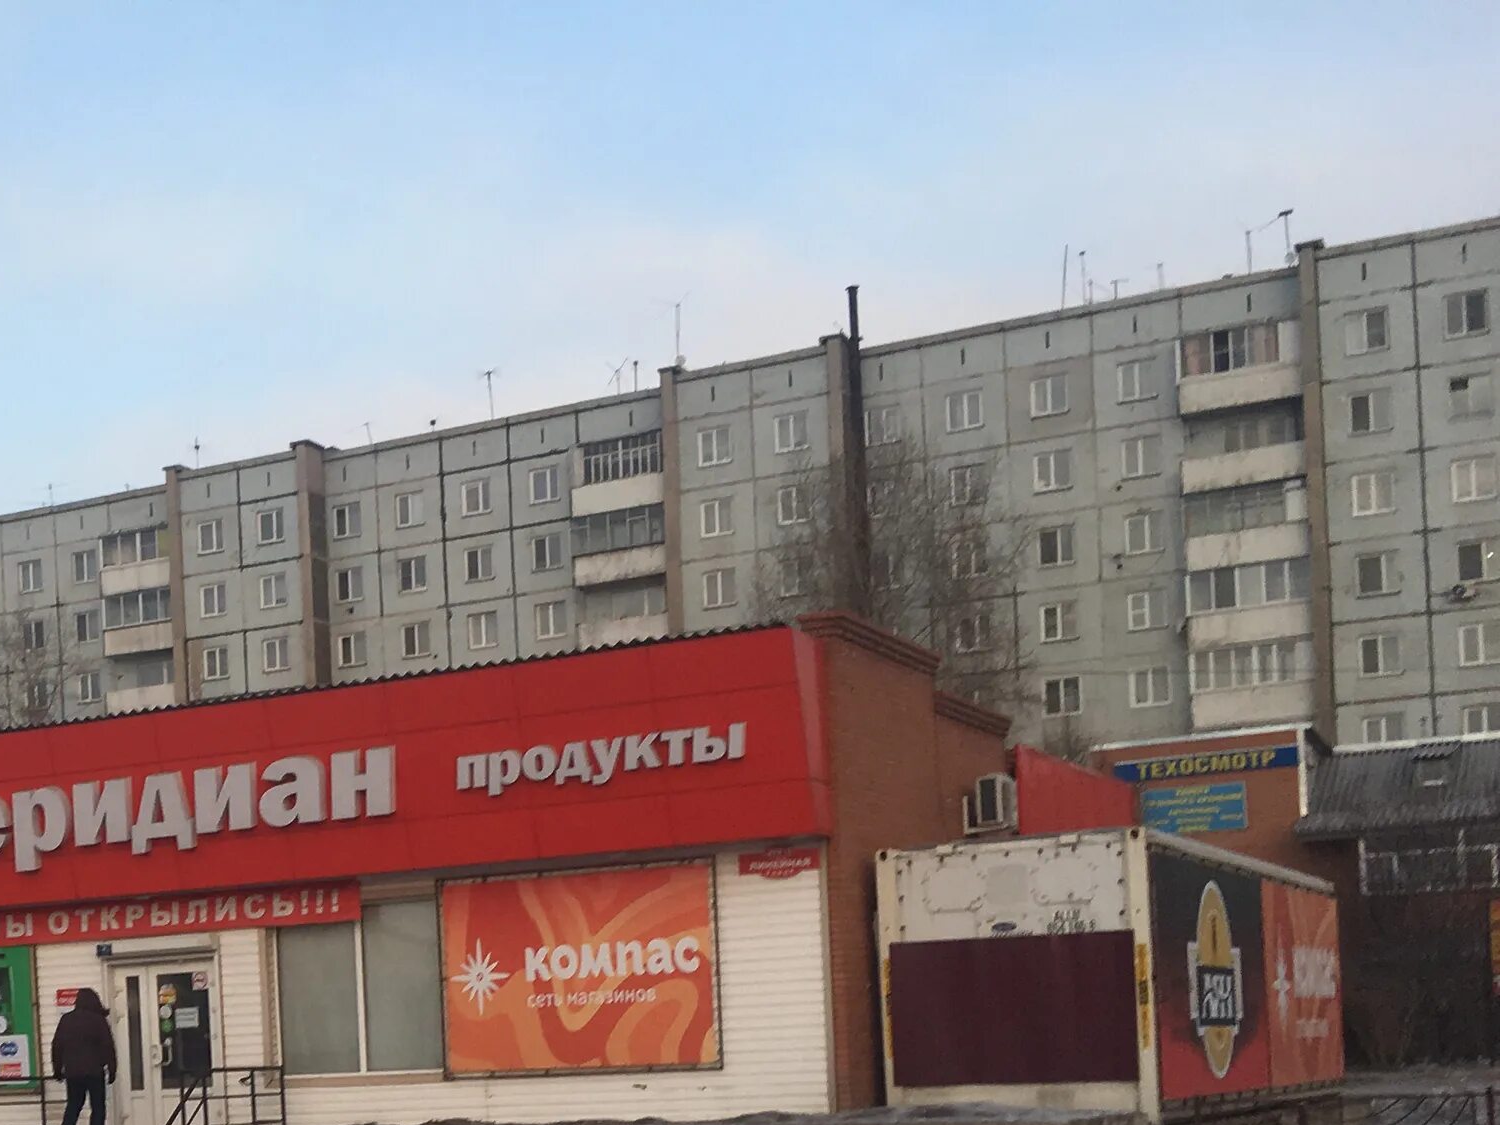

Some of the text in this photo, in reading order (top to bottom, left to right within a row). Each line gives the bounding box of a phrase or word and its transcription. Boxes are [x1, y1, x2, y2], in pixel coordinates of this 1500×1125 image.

[455, 720, 748, 797] продукты
[1135, 751, 1277, 780] ТЕХОСМОТР
[47, 888, 341, 935] ОТКРЫЛИСЬ!!!
[524, 935, 701, 982] компас
[527, 987, 658, 1008] сеть магазинов
